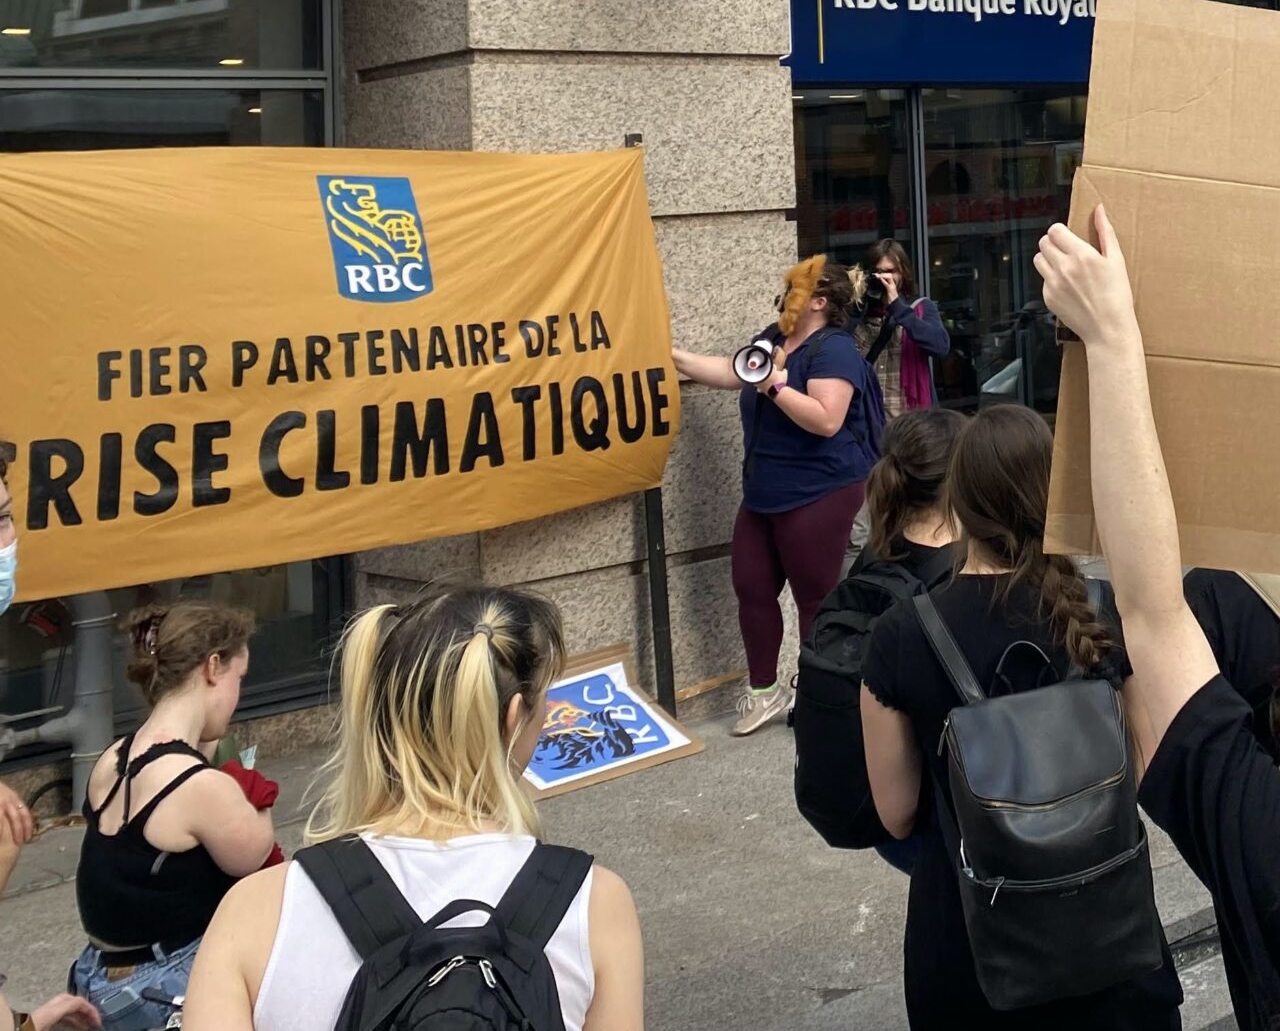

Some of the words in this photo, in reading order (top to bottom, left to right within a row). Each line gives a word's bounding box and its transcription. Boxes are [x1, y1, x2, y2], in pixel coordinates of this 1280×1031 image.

[347, 263, 426, 293] RBC
[97, 350, 208, 401] FIER
[231, 322, 509, 387] PARTENAIRE
[518, 315, 562, 357] DE
[570, 310, 611, 352] LA
[0, 420, 231, 531] RISE
[258, 367, 671, 498] CLIMATIQUE
[583, 683, 658, 744] RBC
